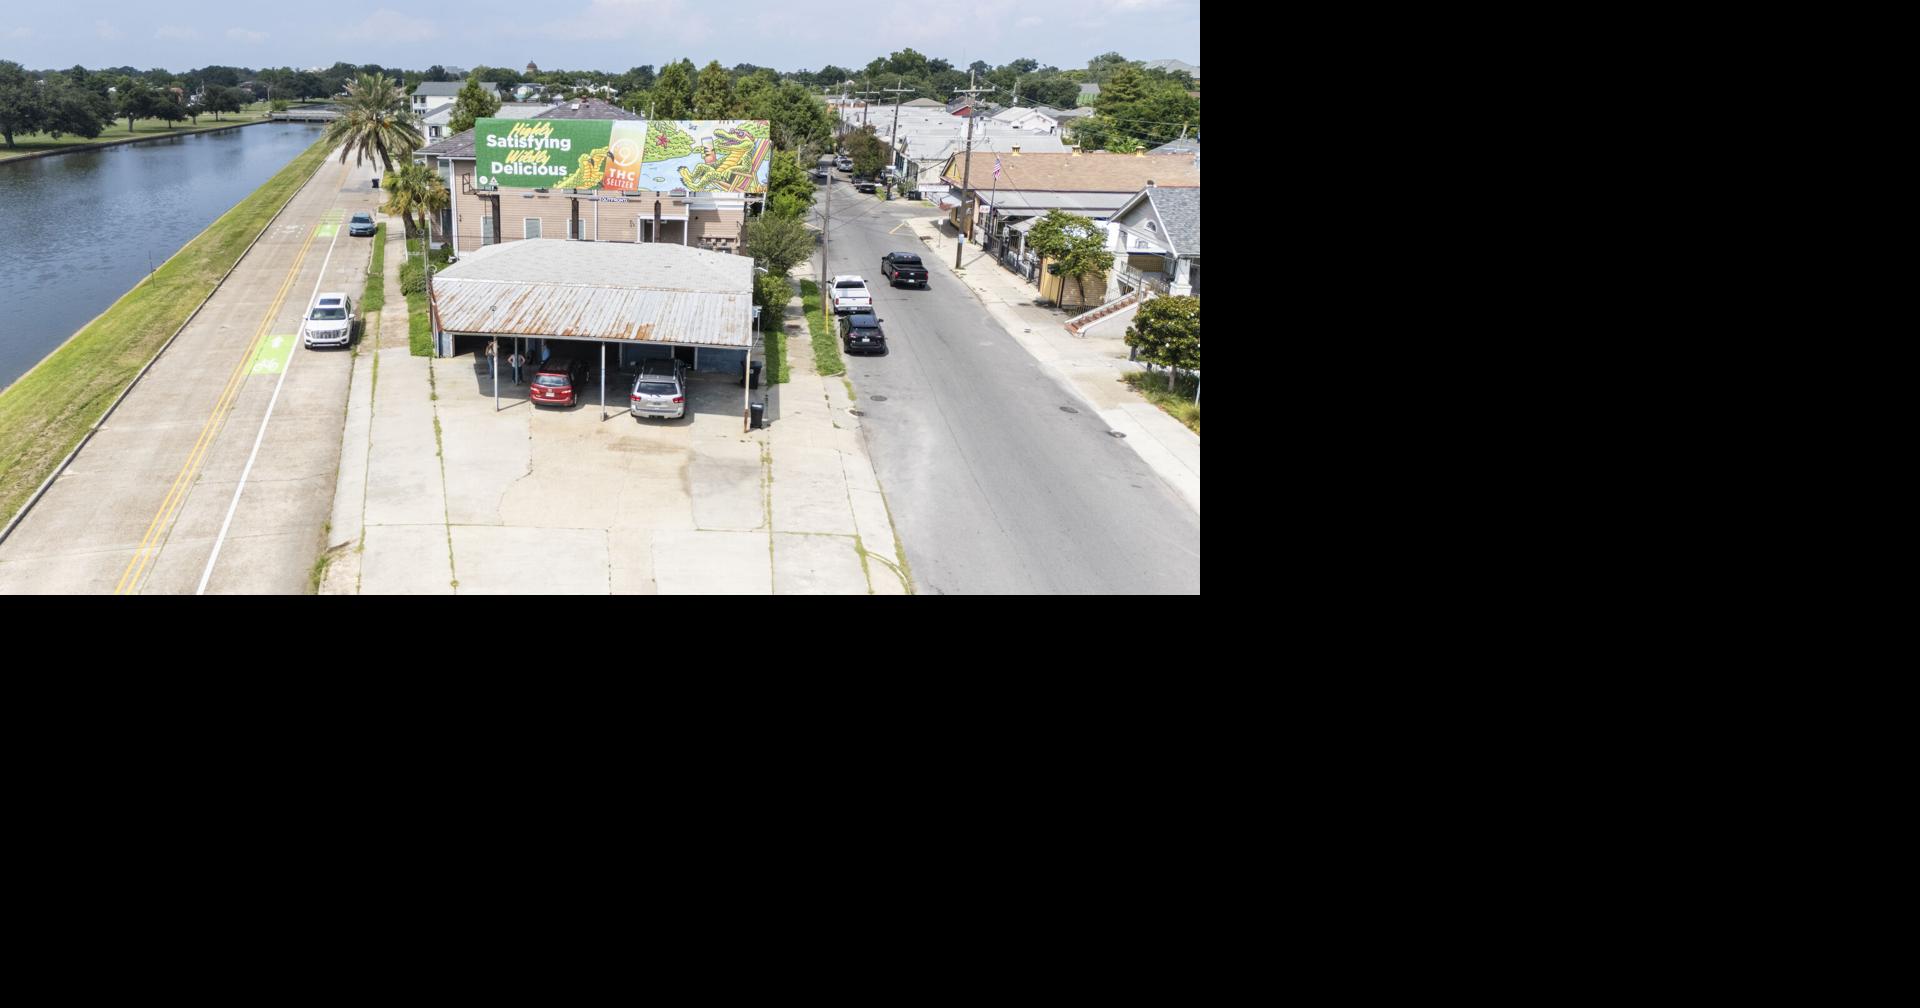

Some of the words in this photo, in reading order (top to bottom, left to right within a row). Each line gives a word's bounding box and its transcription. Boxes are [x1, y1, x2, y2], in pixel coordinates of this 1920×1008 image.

[508, 122, 554, 138] Highly
[486, 134, 571, 151] Satisfying
[505, 150, 550, 166] Wildly
[491, 161, 567, 175] Delicious
[609, 168, 635, 181] THC
[606, 177, 634, 189] SELTZER
